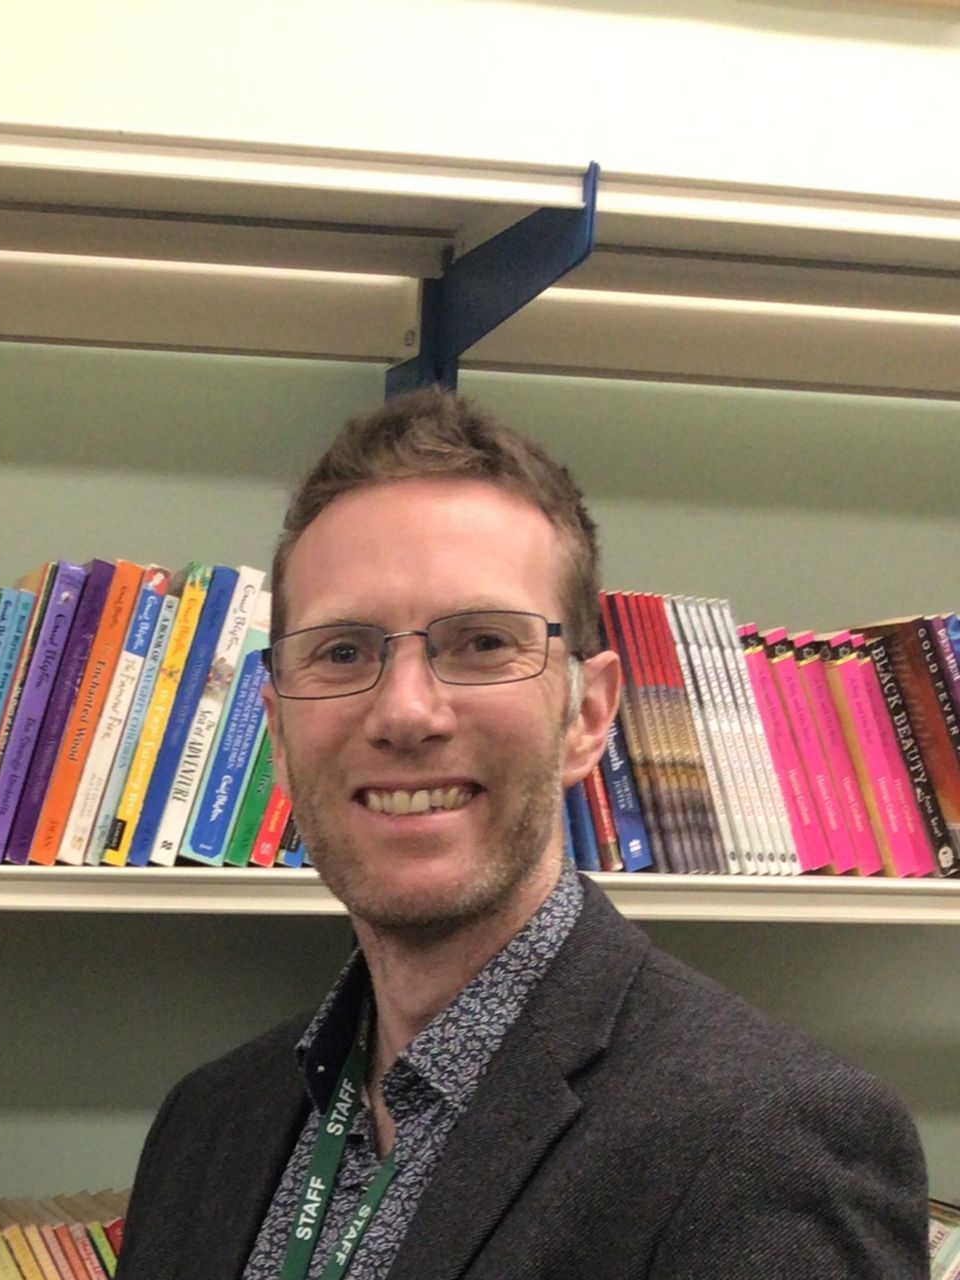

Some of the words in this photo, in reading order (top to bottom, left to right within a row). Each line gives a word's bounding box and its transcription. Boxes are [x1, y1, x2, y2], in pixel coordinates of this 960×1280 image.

[236, 585, 256, 612] Enid
[47, 614, 66, 645] Enid
[153, 623, 168, 650] BOOK
[226, 616, 246, 651] Blyton
[36, 650, 60, 688] Blyton
[80, 661, 106, 722] Enchanted
[917, 628, 939, 673] GOLD
[935, 681, 957, 736] FEVER
[871, 646, 906, 708] BLACK
[895, 712, 928, 784] BEAUTY
[68, 728, 86, 762] Wood
[172, 737, 203, 804] ADVENTURE
[327, 1078, 356, 1136] STAFF
[296, 1176, 326, 1240] STAFF
[336, 1204, 372, 1265] STAFF
